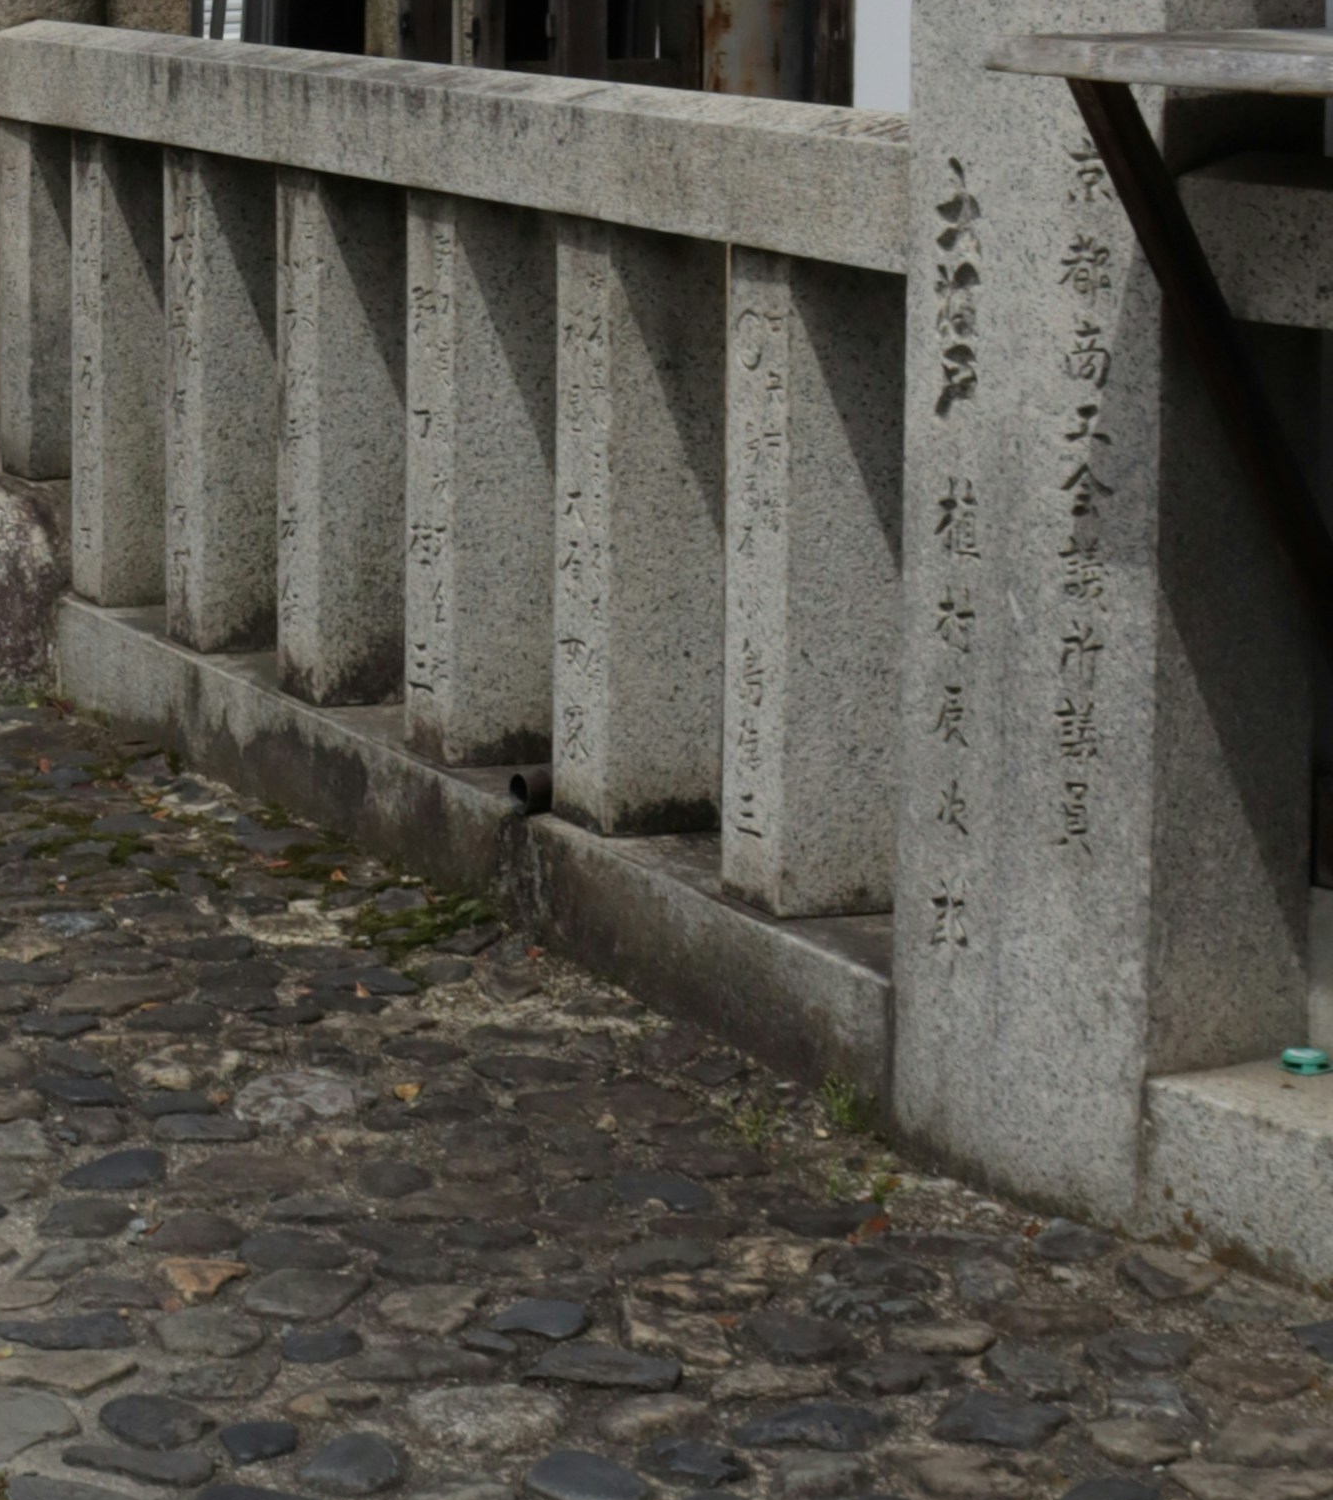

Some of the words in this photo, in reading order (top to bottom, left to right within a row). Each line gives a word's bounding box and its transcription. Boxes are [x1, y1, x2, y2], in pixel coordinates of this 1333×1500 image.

[1055, 136, 1114, 859] 京都商工会議所議員
